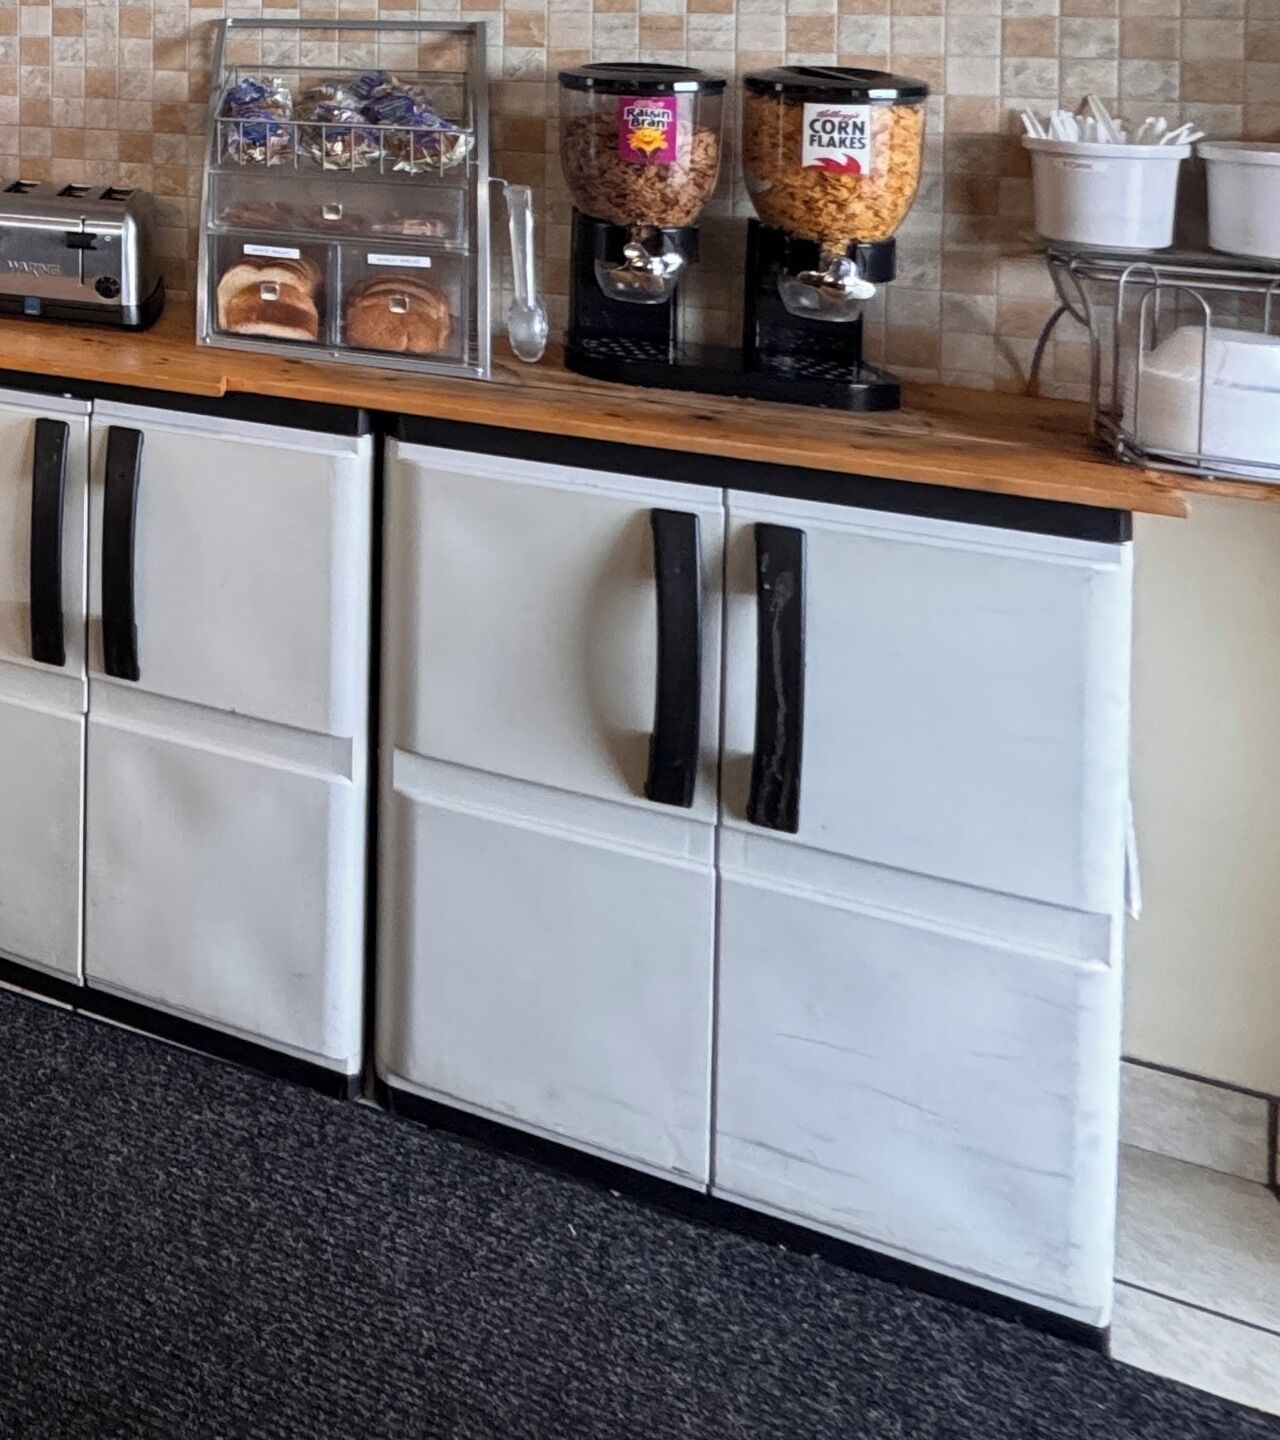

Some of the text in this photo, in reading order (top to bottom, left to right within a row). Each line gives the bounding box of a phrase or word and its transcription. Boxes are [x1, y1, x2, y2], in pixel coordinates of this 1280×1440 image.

[626, 107, 671, 120] Raisin
[631, 117, 666, 129] Bran
[809, 118, 865, 136] CORN
[809, 134, 867, 150] FLAKES
